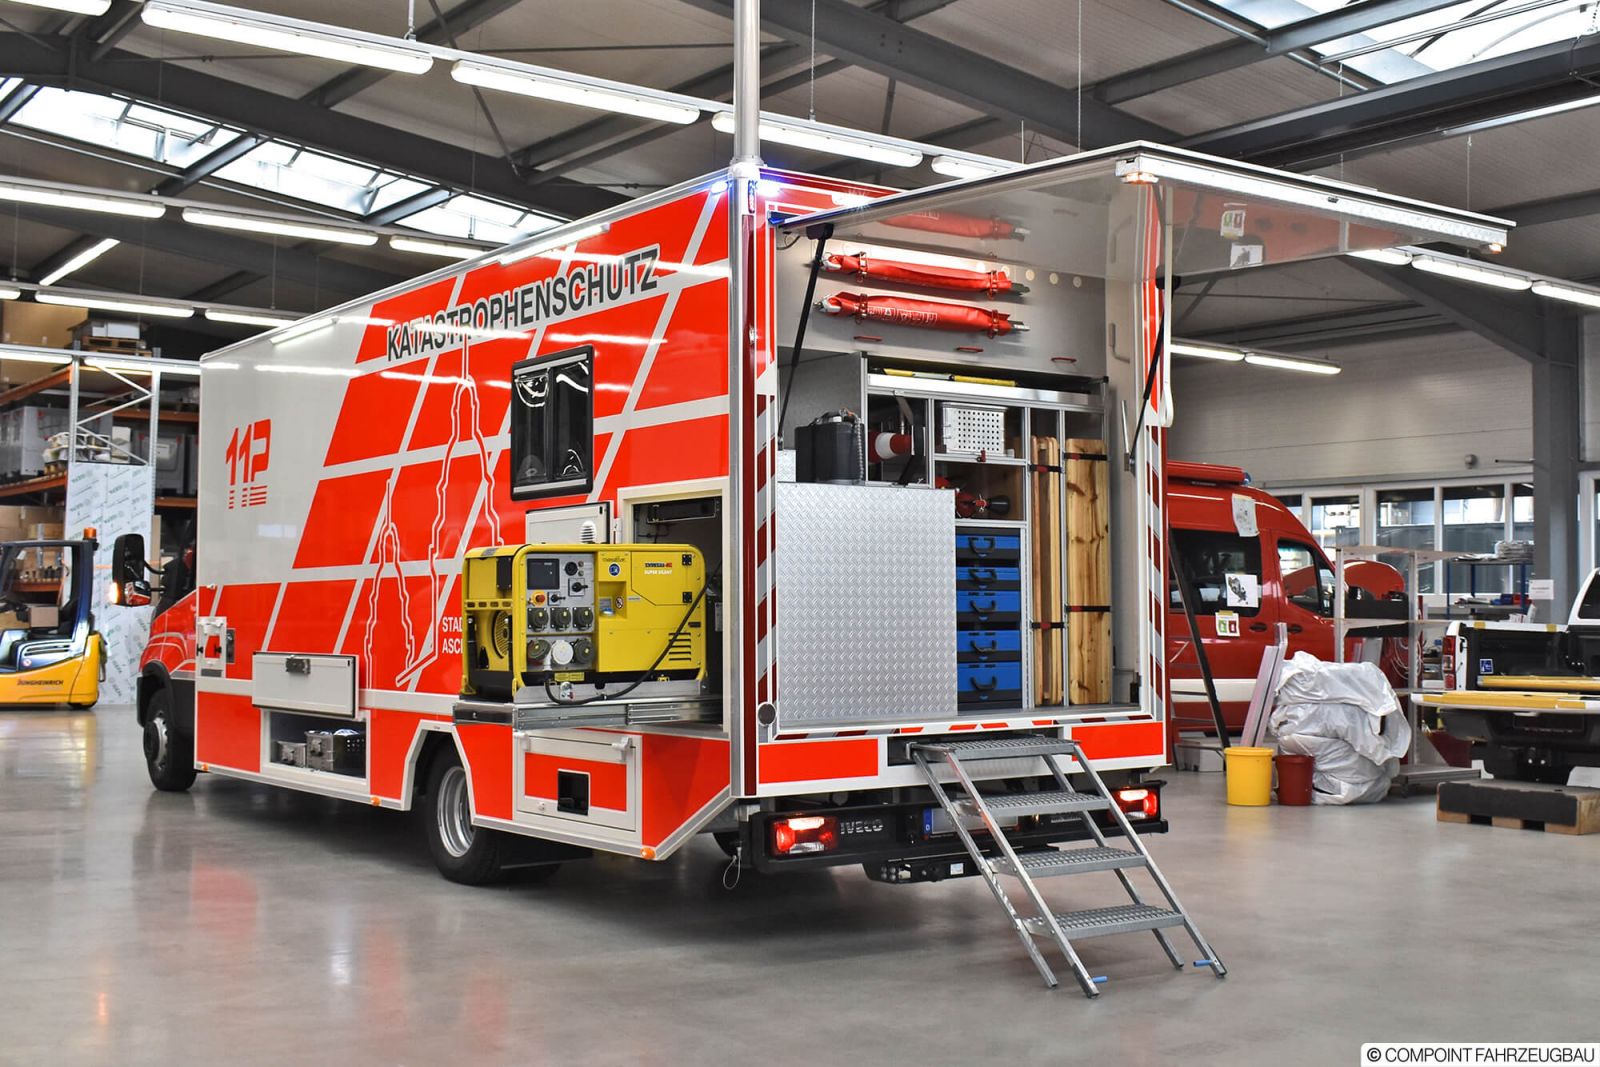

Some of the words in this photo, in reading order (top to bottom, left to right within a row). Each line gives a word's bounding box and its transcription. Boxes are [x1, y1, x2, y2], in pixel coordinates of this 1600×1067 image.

[387, 247, 659, 362] KATASTROPHENSCHUTZ
[442, 638, 463, 654] ASC
[840, 818, 884, 835] IVECO
